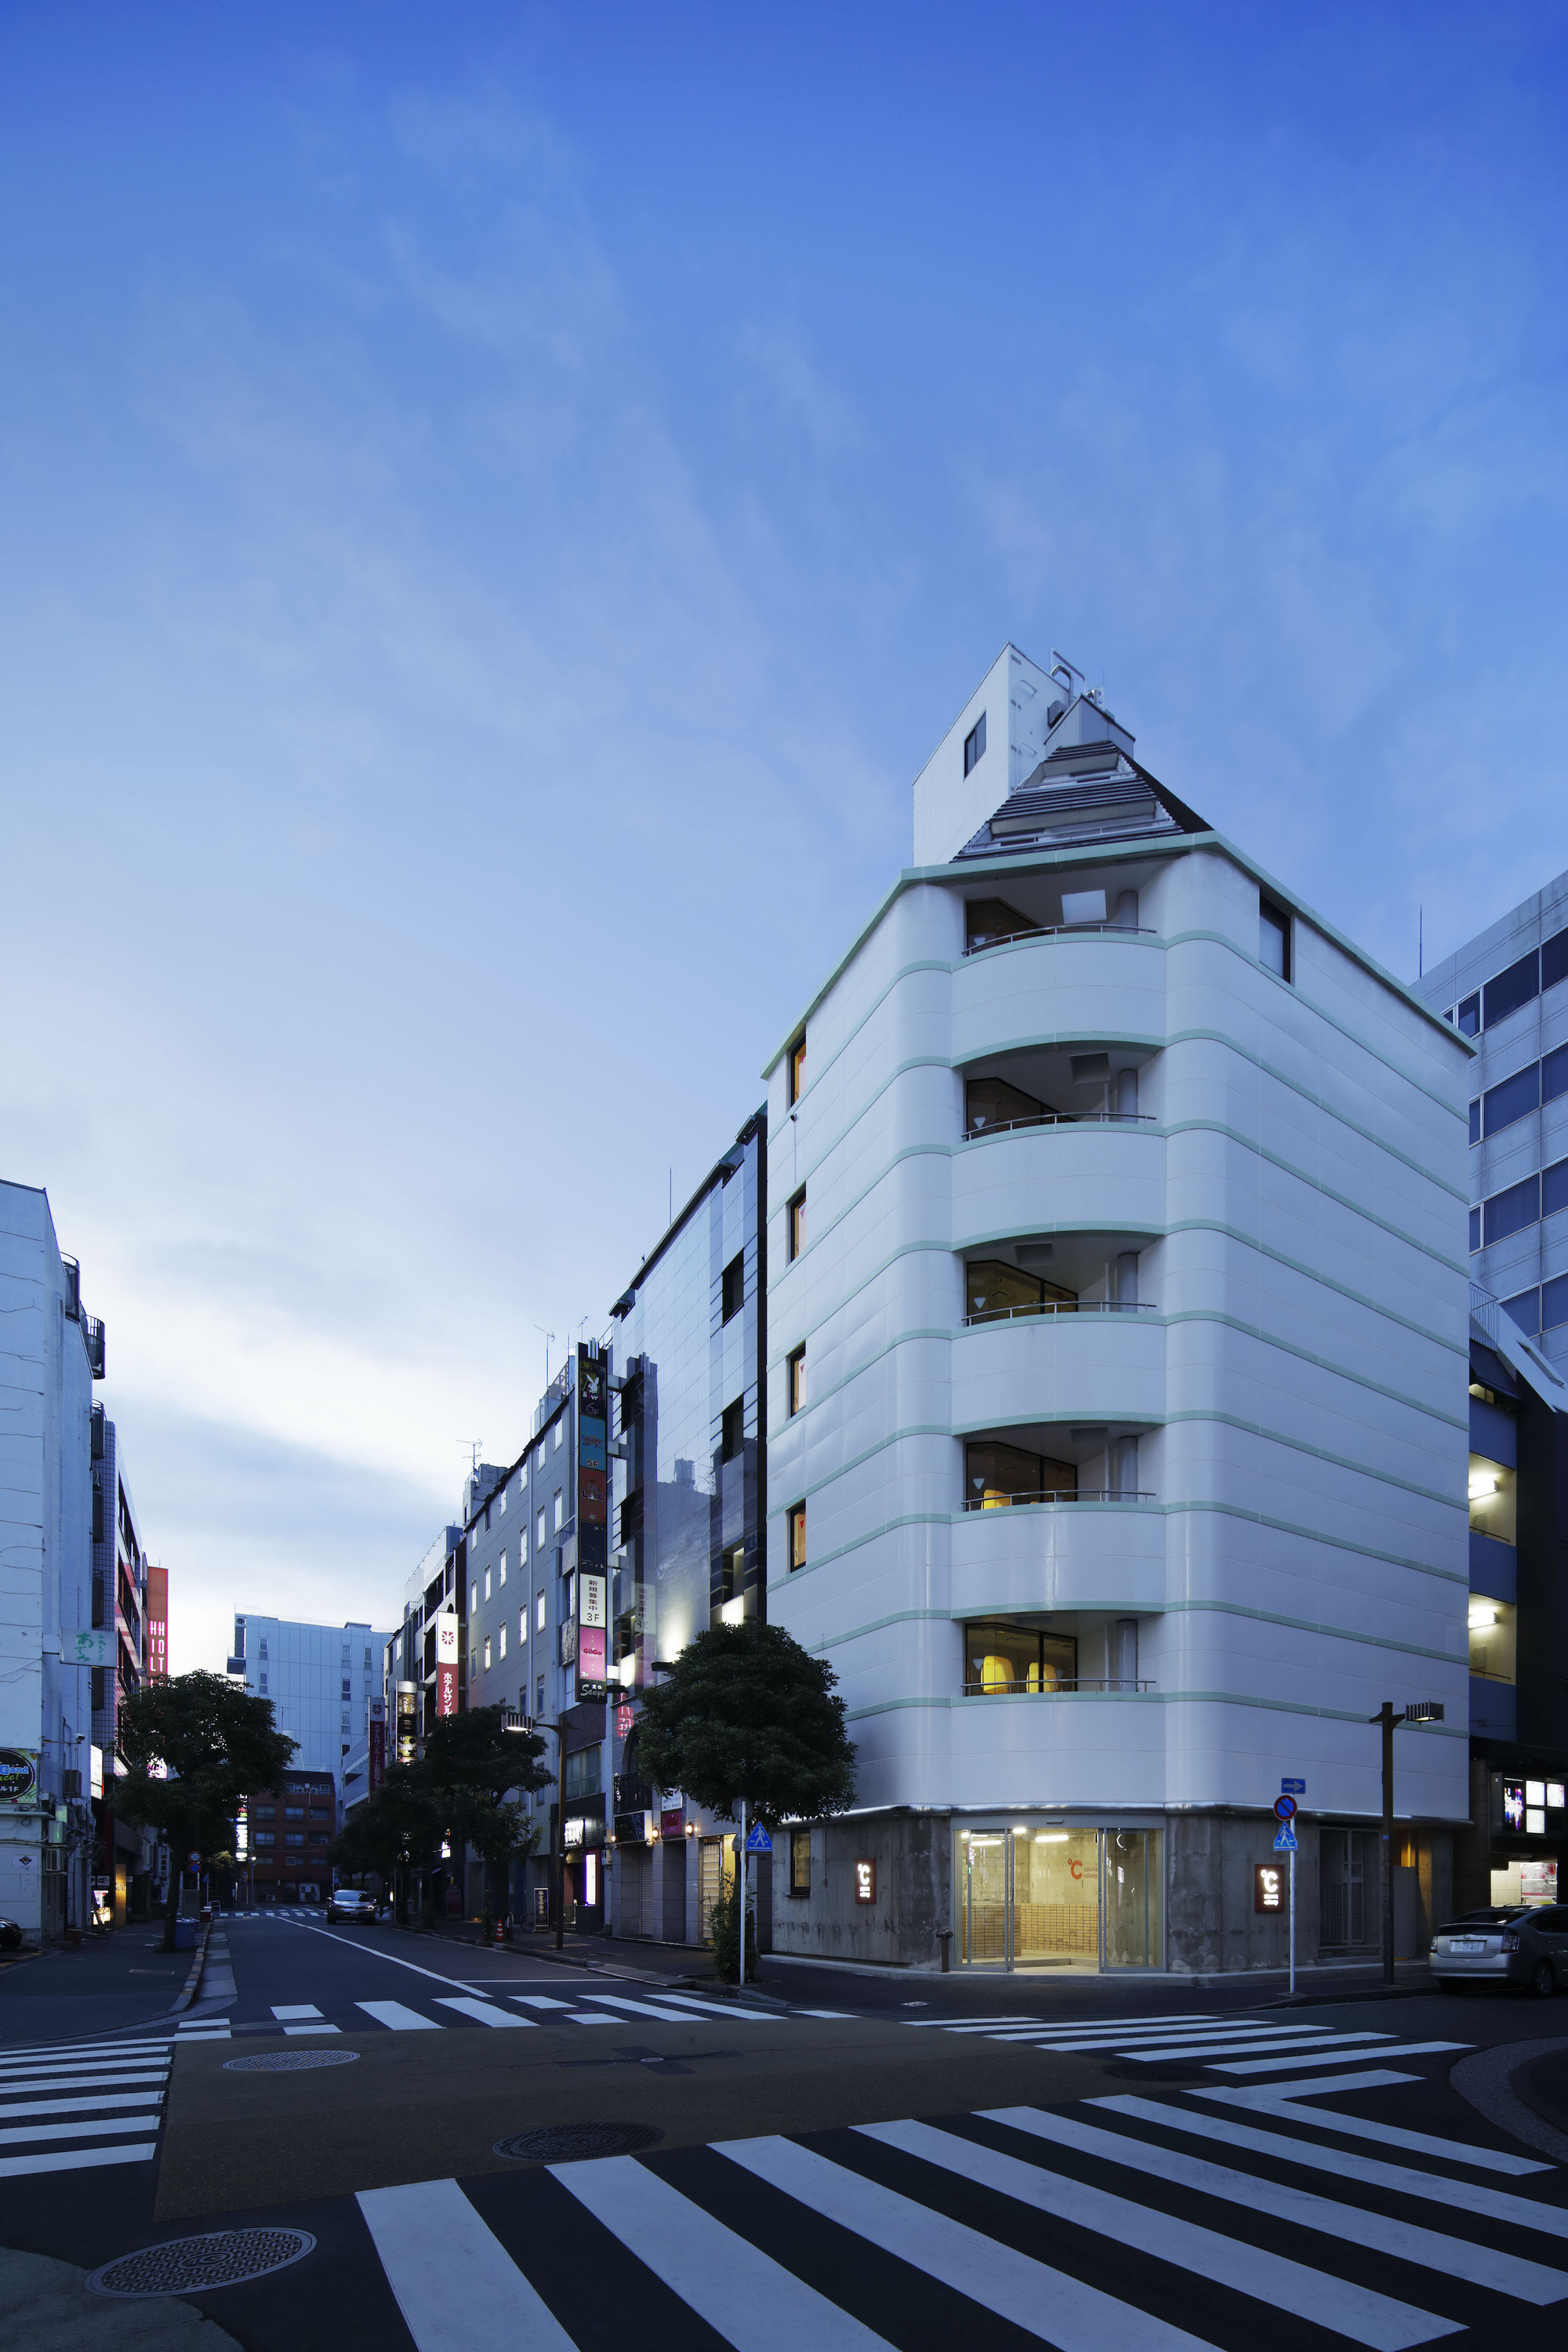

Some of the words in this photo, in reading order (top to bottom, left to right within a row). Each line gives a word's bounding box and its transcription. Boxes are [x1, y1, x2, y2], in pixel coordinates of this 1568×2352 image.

[586, 1403, 599, 1415] 6F
[587, 1459, 598, 1468] 5F
[582, 1489, 604, 1501] LAX
[588, 1579, 598, 1612] 新規募集中
[586, 1613, 600, 1622] 3F
[444, 1672, 452, 1717] ホテルサンル
[580, 1684, 605, 1698] Sanyu
